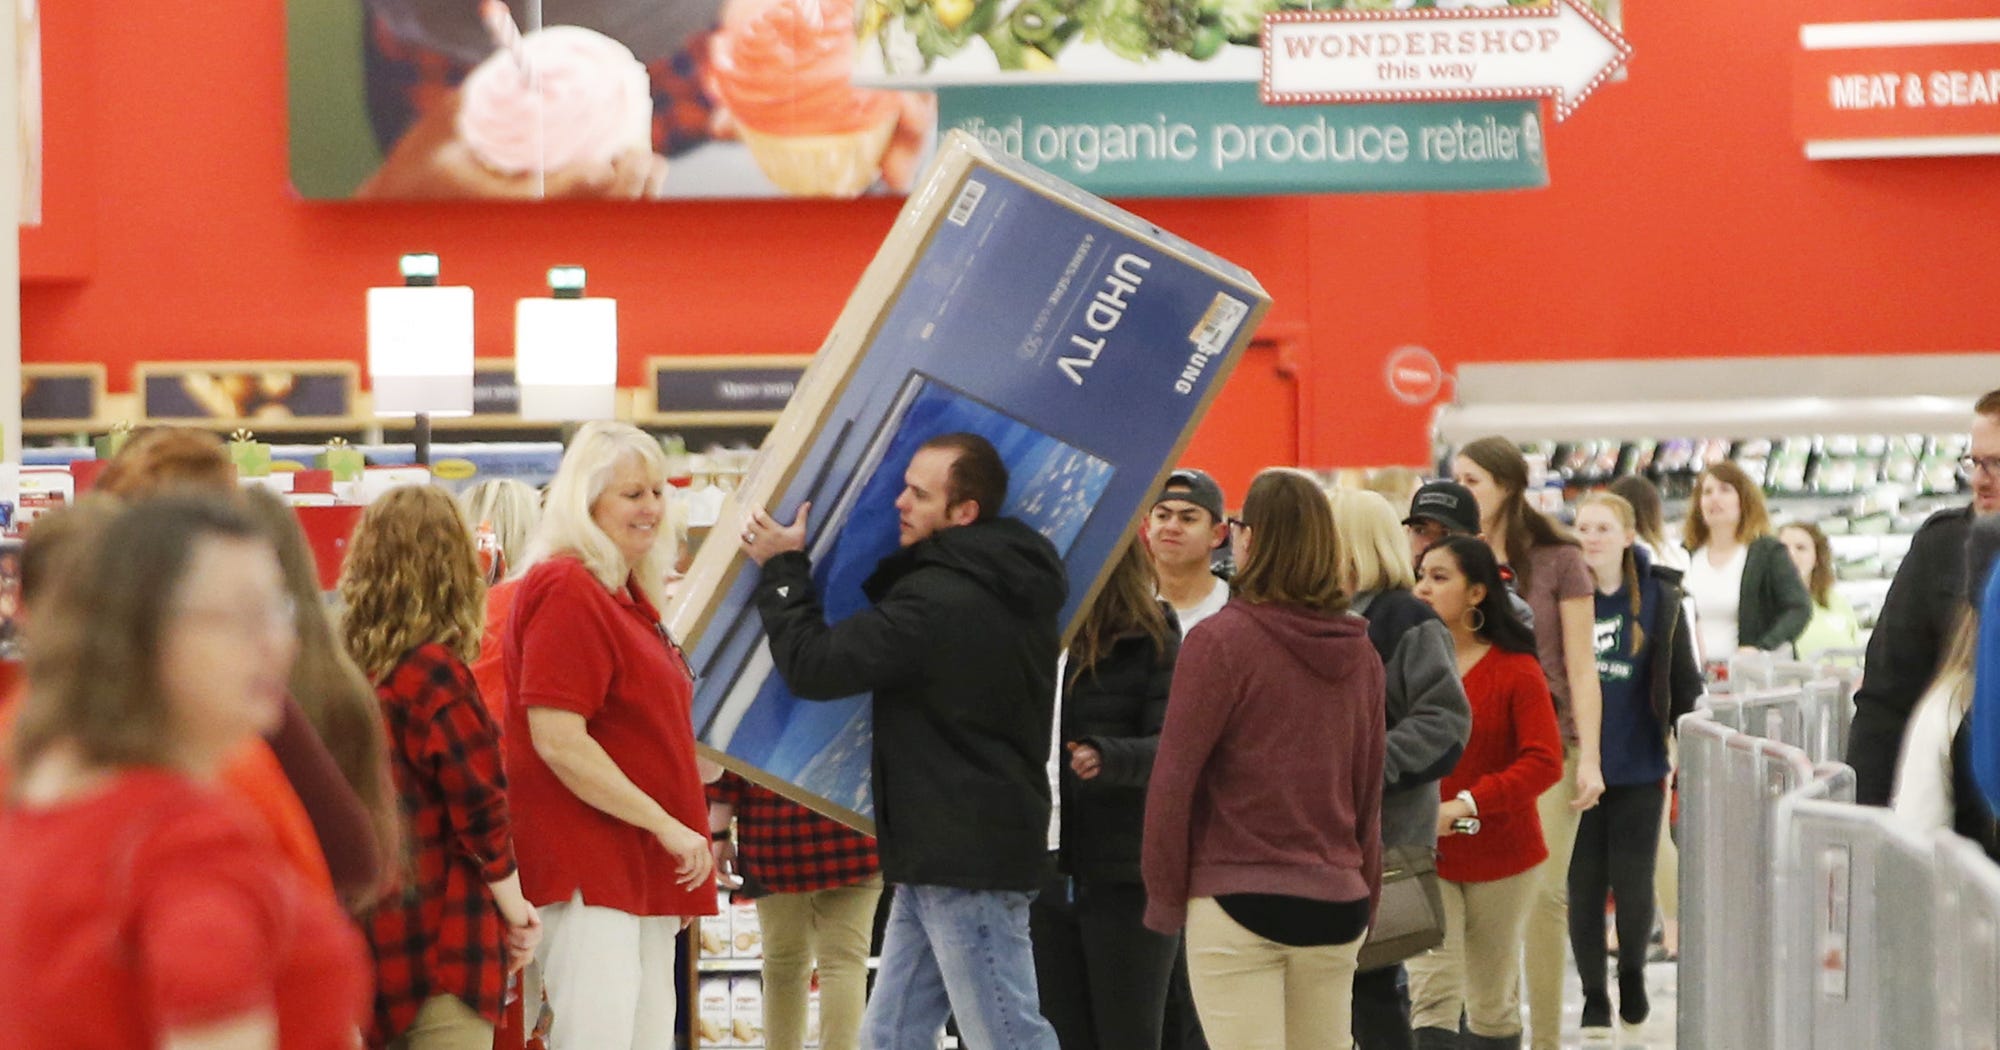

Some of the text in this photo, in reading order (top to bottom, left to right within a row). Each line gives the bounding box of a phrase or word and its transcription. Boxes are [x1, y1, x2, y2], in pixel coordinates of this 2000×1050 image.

[1283, 28, 1560, 60] WONDERSHOP
[1377, 61, 1477, 83] this way
[1829, 73, 1900, 109] MEAT
[1903, 72, 1926, 108] &
[1033, 112, 1199, 174] organic
[1211, 114, 1410, 171] produce
[1419, 114, 1520, 163] retailer
[1056, 252, 1152, 386] UHD TV
[1174, 342, 1213, 395] SUNG
